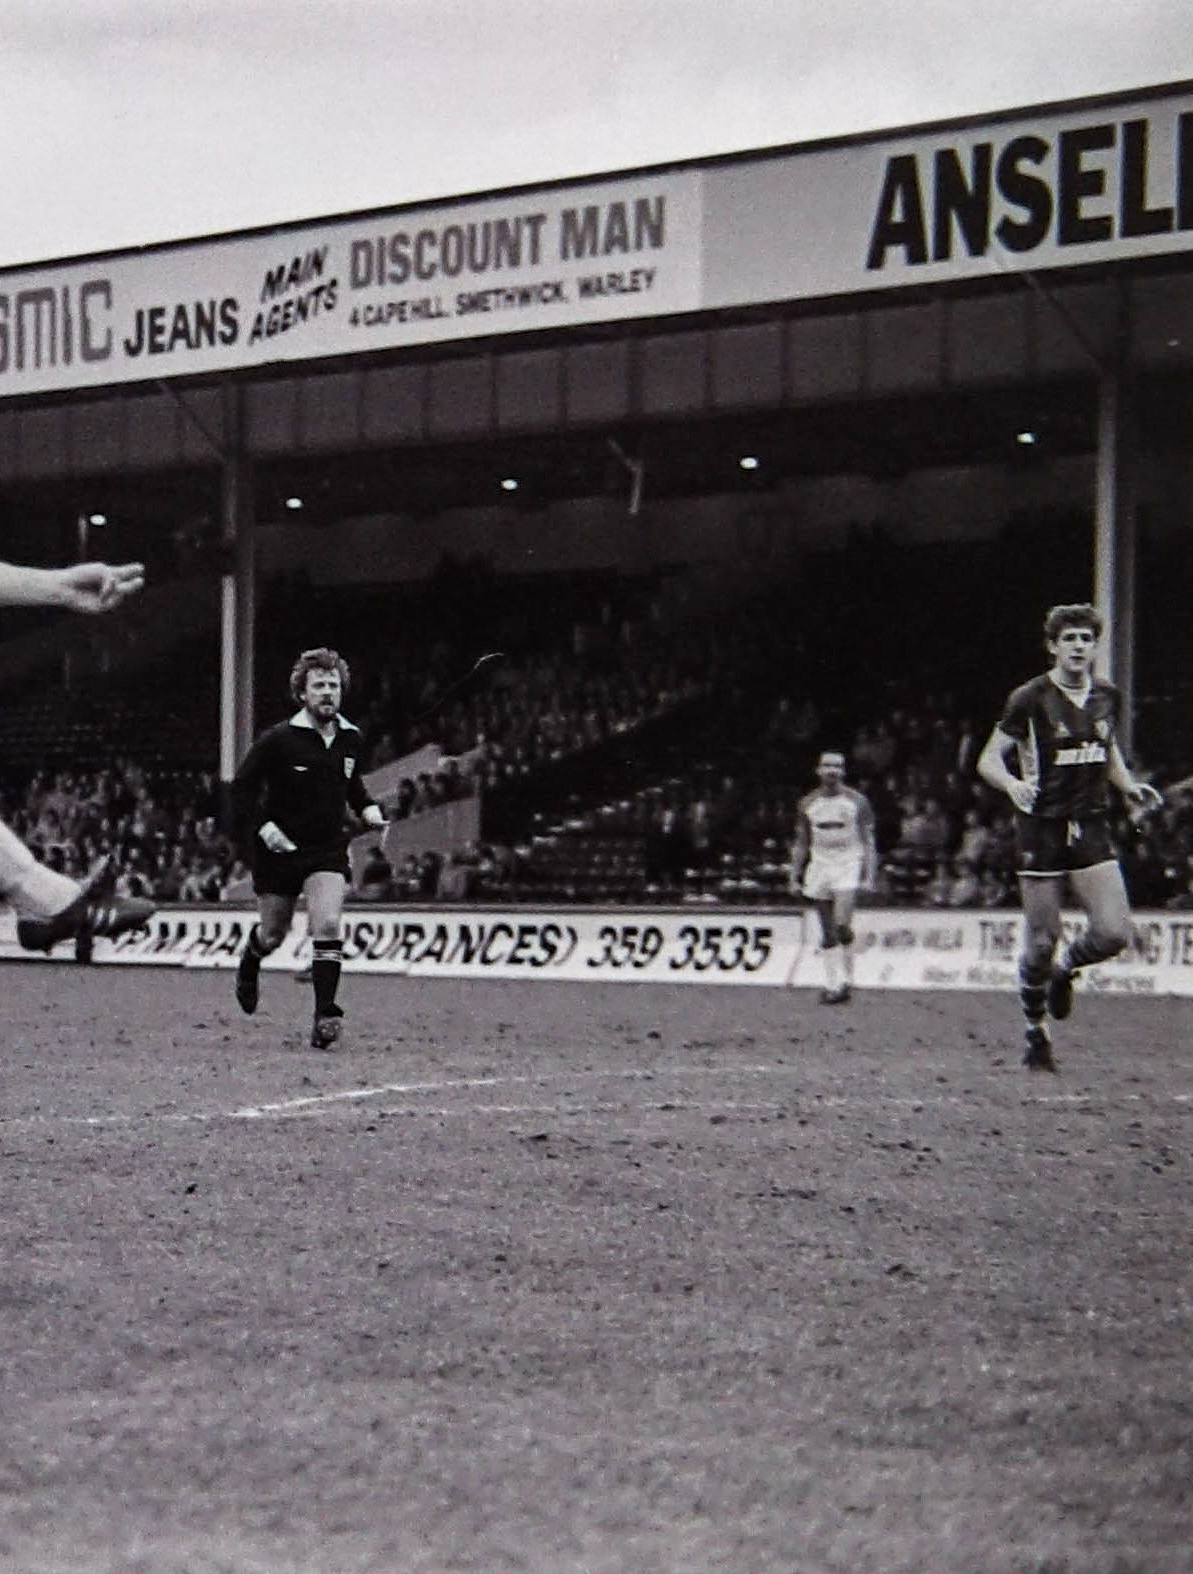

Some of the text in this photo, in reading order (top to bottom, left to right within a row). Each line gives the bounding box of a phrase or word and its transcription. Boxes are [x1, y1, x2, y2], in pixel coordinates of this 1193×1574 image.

[865, 113, 1193, 270] ANSEL
[260, 244, 328, 304] MAIN
[349, 196, 666, 290] DISCOUNT MAN
[123, 299, 239, 357] JEANS
[248, 278, 338, 346] AGENTS
[587, 925, 665, 968] 359
[669, 925, 774, 972] 3535
